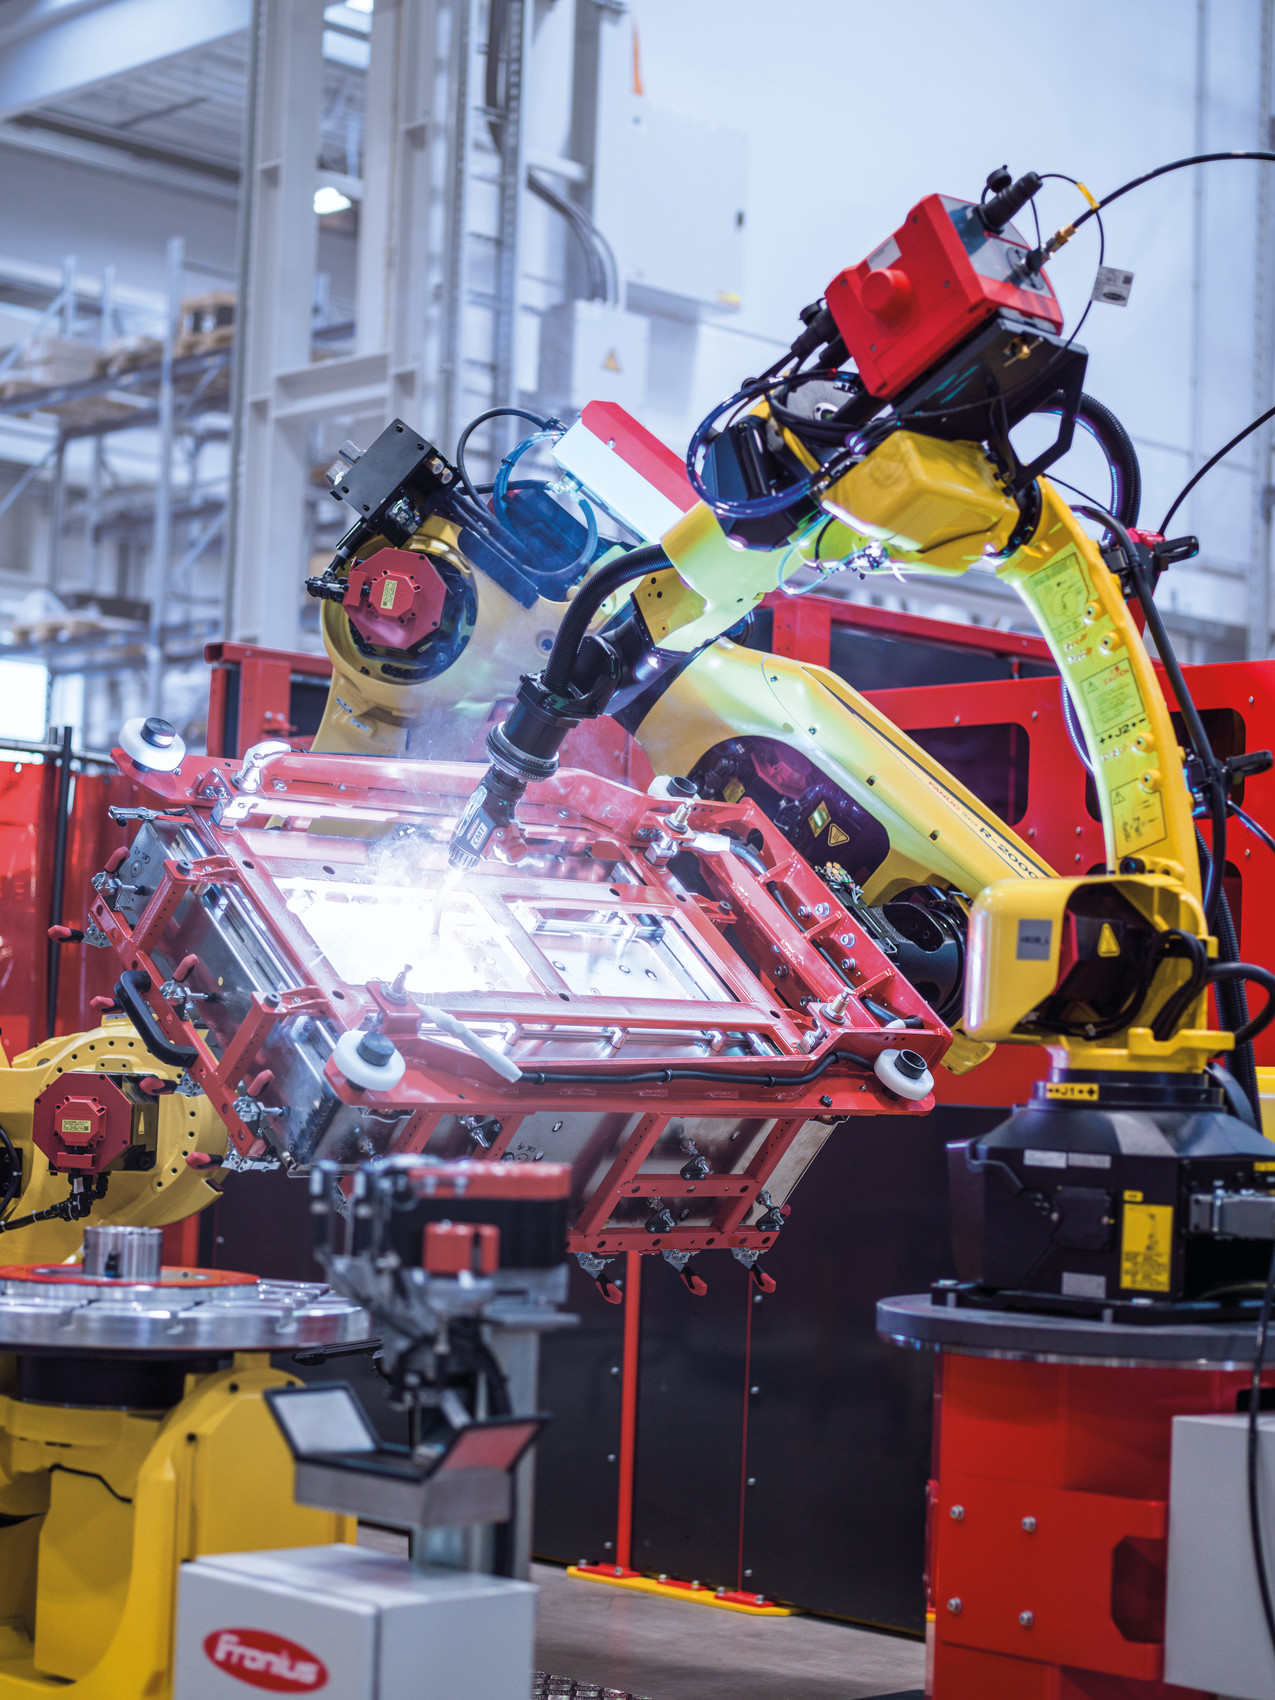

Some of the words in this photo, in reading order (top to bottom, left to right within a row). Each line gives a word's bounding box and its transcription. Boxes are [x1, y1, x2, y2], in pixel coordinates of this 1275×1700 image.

[1115, 724, 1130, 737] J2
[928, 781, 960, 811] FANUC
[473, 825, 485, 845] CMT
[214, 1633, 320, 1684] Fronius
